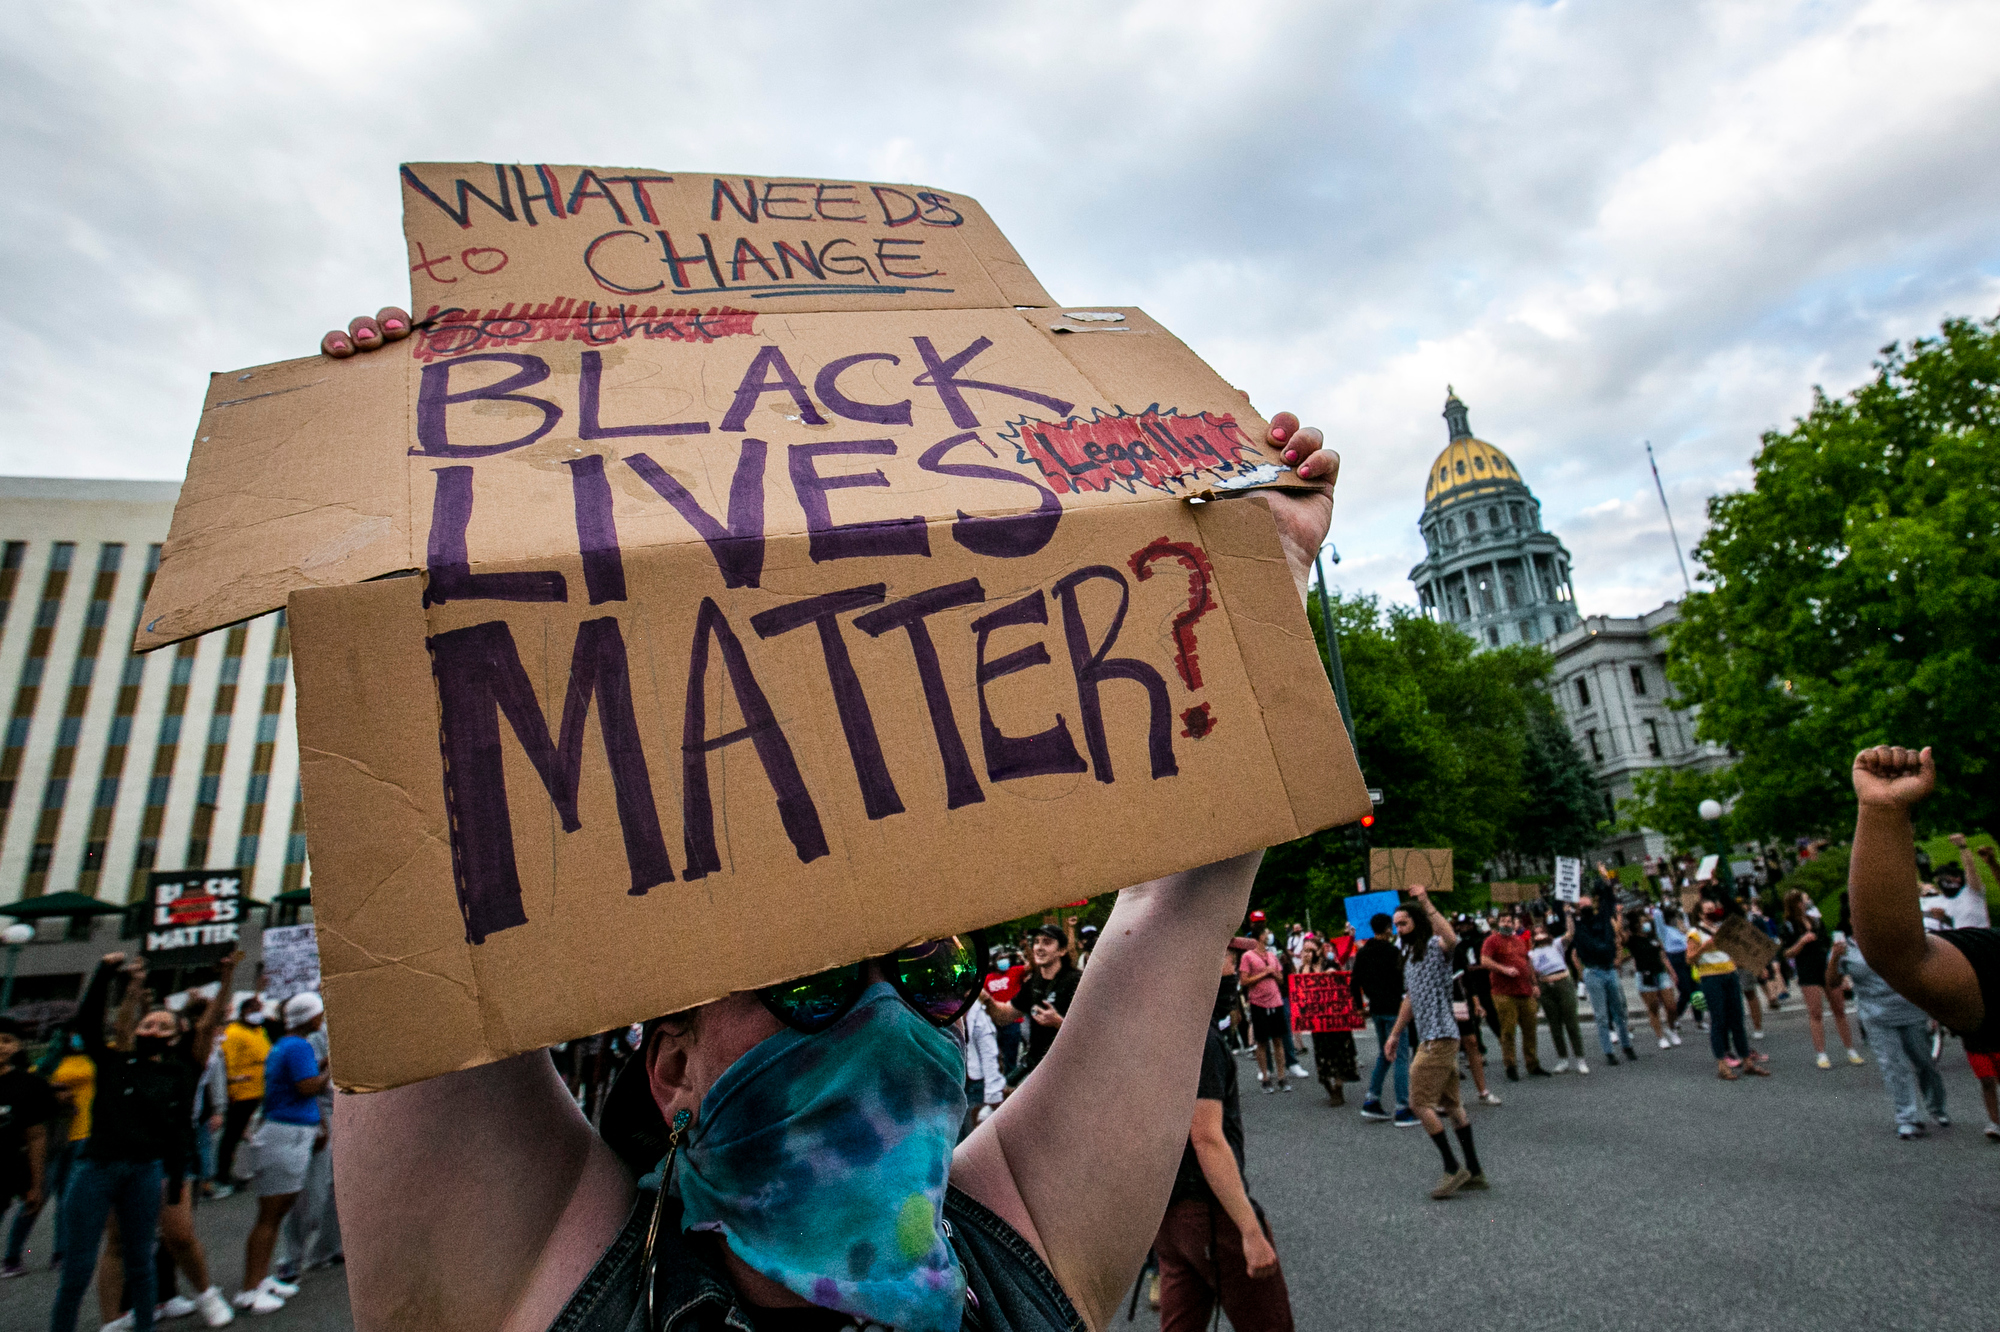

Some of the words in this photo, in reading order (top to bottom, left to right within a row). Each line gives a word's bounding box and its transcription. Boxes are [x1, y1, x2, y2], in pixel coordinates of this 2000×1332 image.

[401, 163, 673, 228] WHAT
[711, 178, 965, 228] NEEDS
[412, 240, 509, 283] to
[583, 229, 946, 295] CHANGE
[580, 301, 726, 343] that
[407, 335, 1075, 458] BLACK
[422, 430, 1064, 610] LIVES
[425, 534, 1218, 946] MATTER?
[155, 878, 241, 906] BLCK
